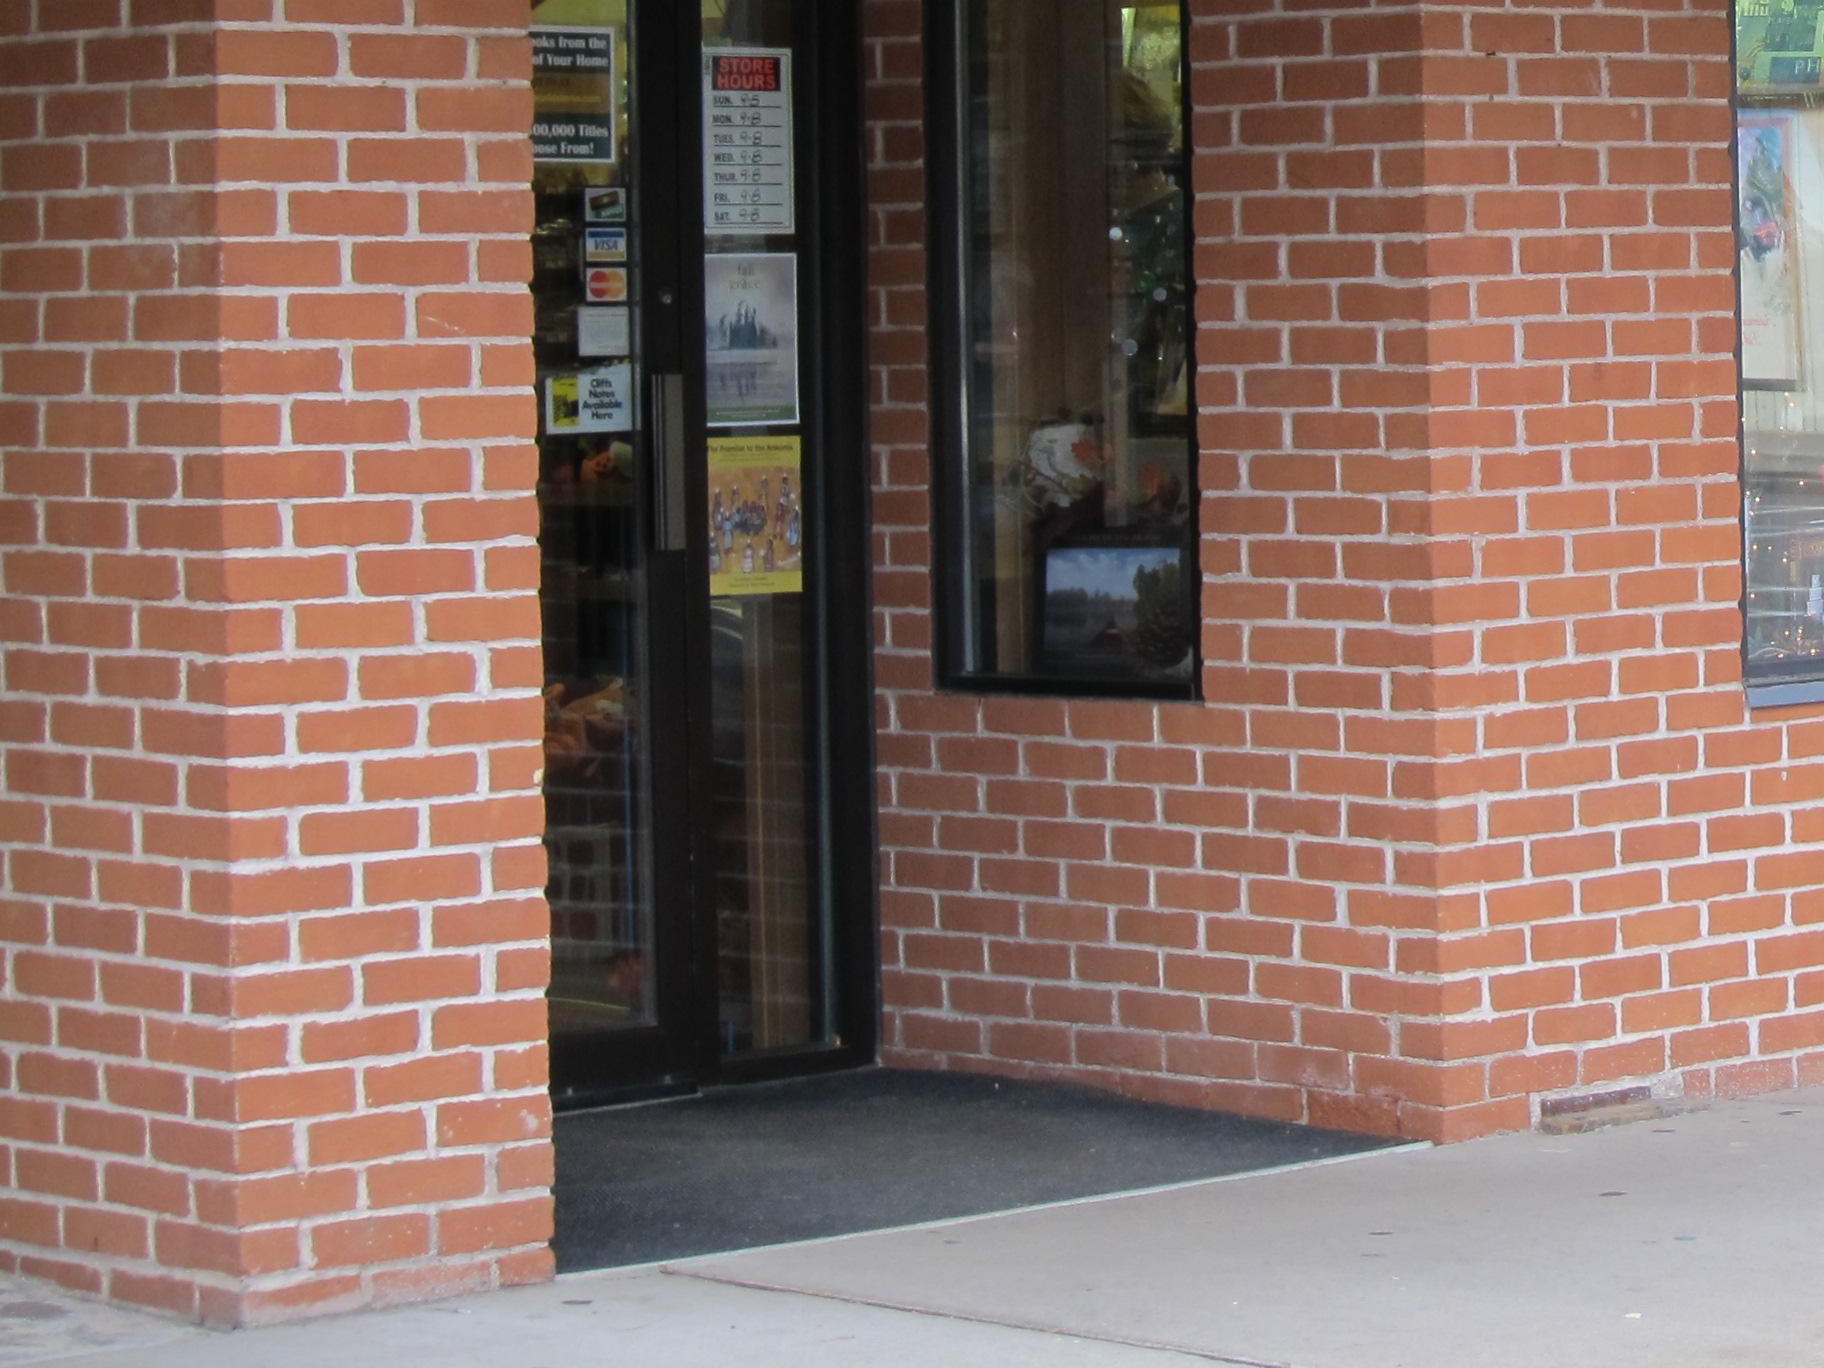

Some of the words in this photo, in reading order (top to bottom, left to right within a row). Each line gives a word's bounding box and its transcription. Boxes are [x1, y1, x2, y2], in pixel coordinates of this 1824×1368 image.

[558, 35, 586, 48] from
[589, 36, 607, 49] the
[532, 53, 543, 65] of
[546, 53, 573, 66] Your
[576, 54, 609, 67] Home
[719, 58, 775, 73] STORE
[717, 74, 776, 90] HOURS
[579, 124, 608, 138] Titles
[561, 141, 594, 155] From!
[594, 239, 619, 251] VISA
[588, 389, 615, 400] Notes
[581, 398, 623, 411] Available
[590, 409, 614, 420] Here
